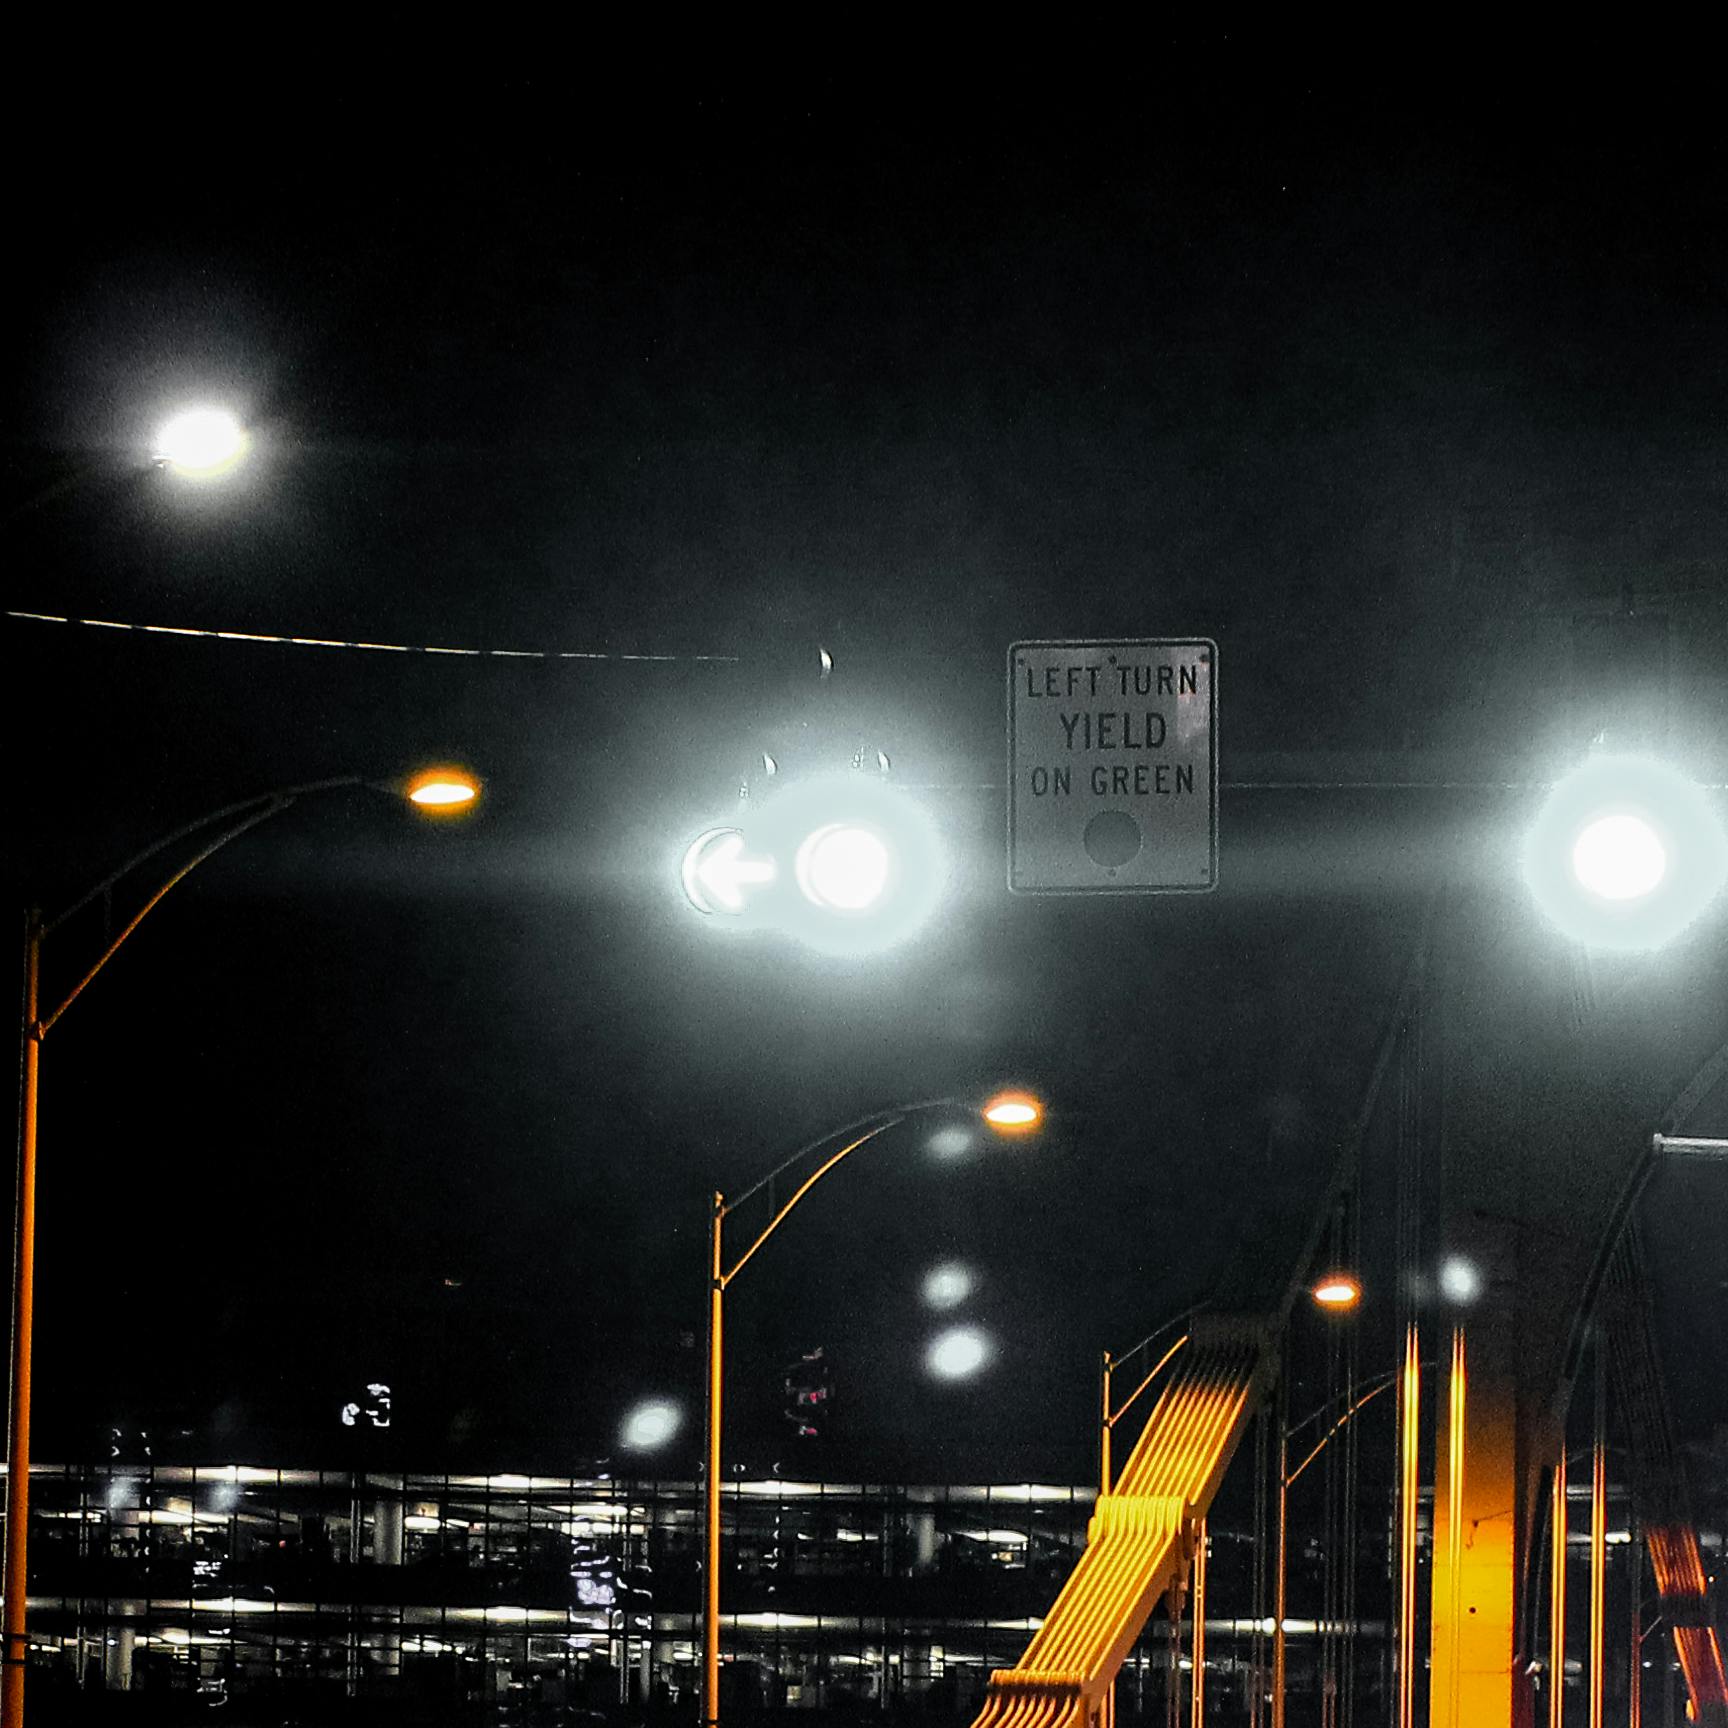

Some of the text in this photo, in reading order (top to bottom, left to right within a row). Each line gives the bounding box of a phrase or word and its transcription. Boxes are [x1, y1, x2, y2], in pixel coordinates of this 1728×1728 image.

[1027, 664, 1198, 697] LEFT TURN
[1060, 712, 1167, 749] YIELD
[1031, 764, 1193, 796] ON GREEN
